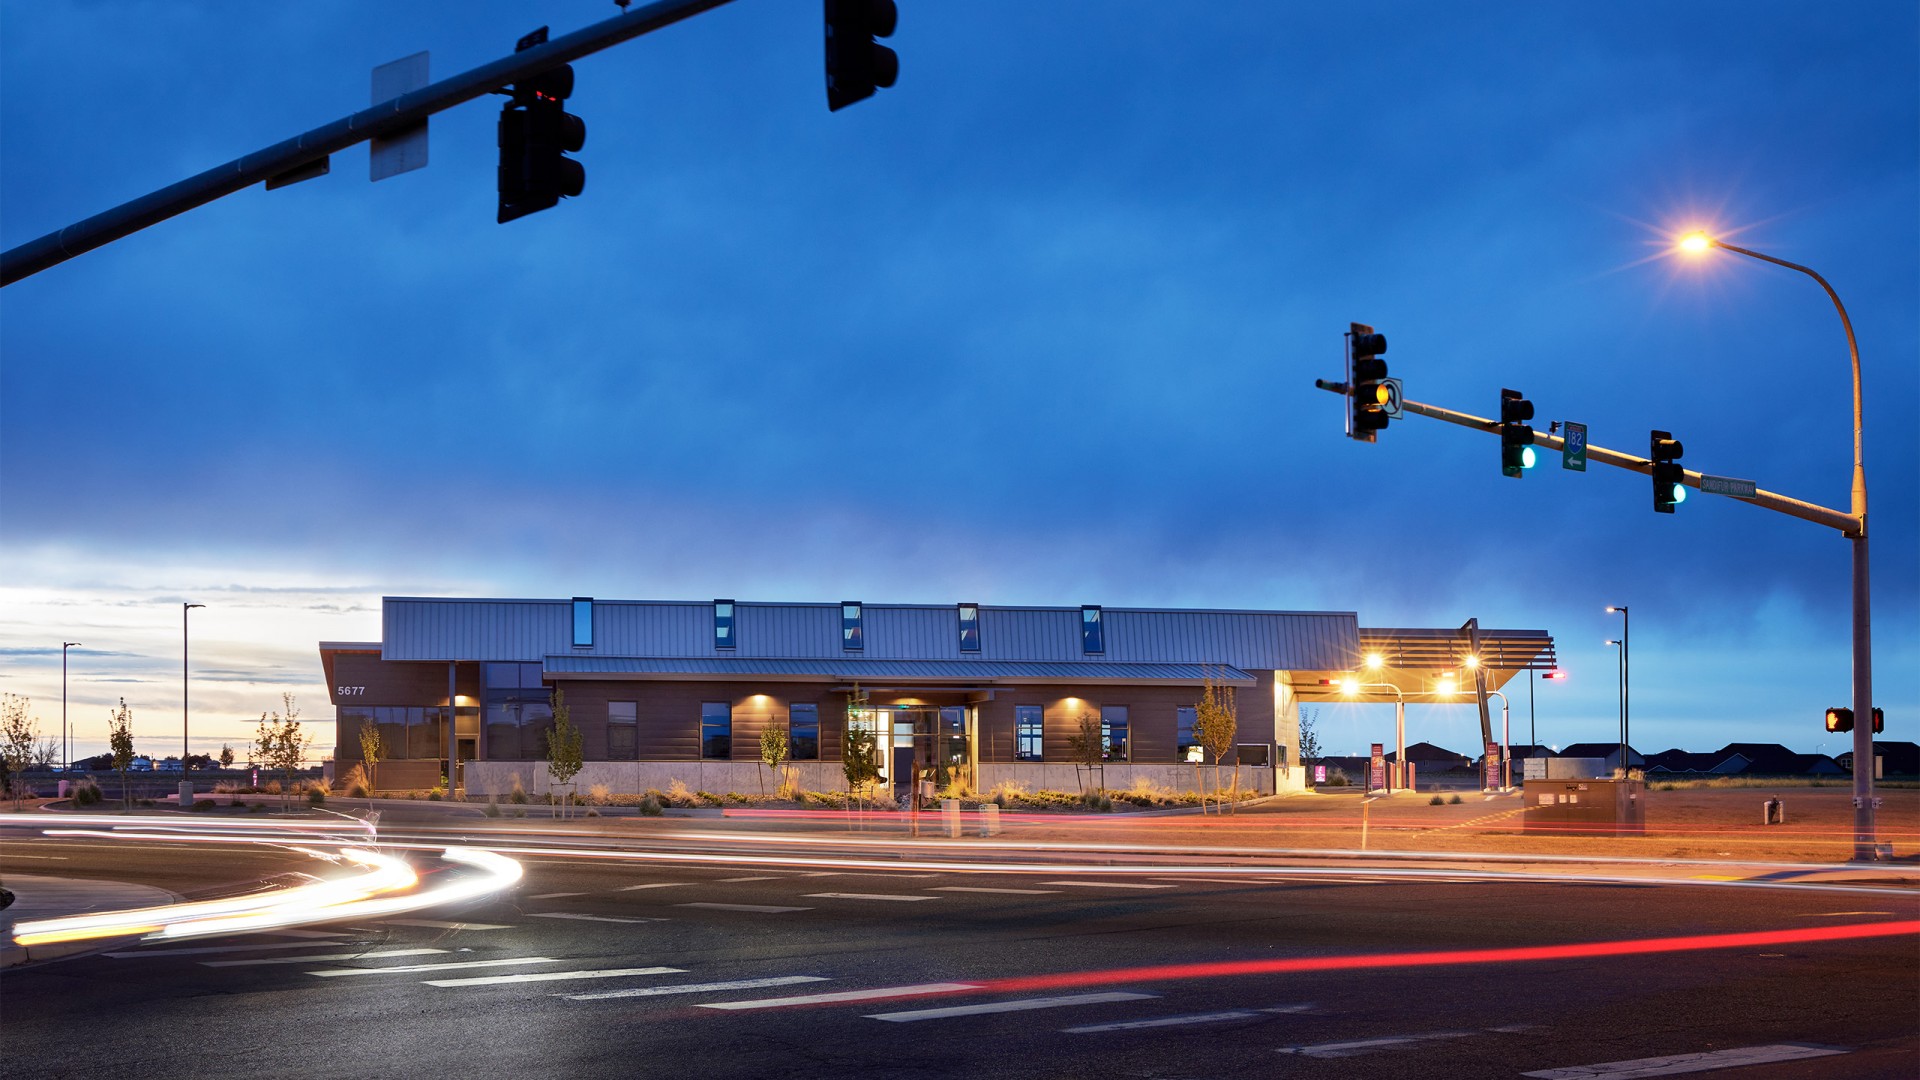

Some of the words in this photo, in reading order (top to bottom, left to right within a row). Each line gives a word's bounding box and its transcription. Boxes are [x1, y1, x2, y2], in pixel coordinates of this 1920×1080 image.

[1568, 431, 1582, 446] 182
[1730, 482, 1754, 495] PARKWAY
[338, 686, 365, 695] 5677
